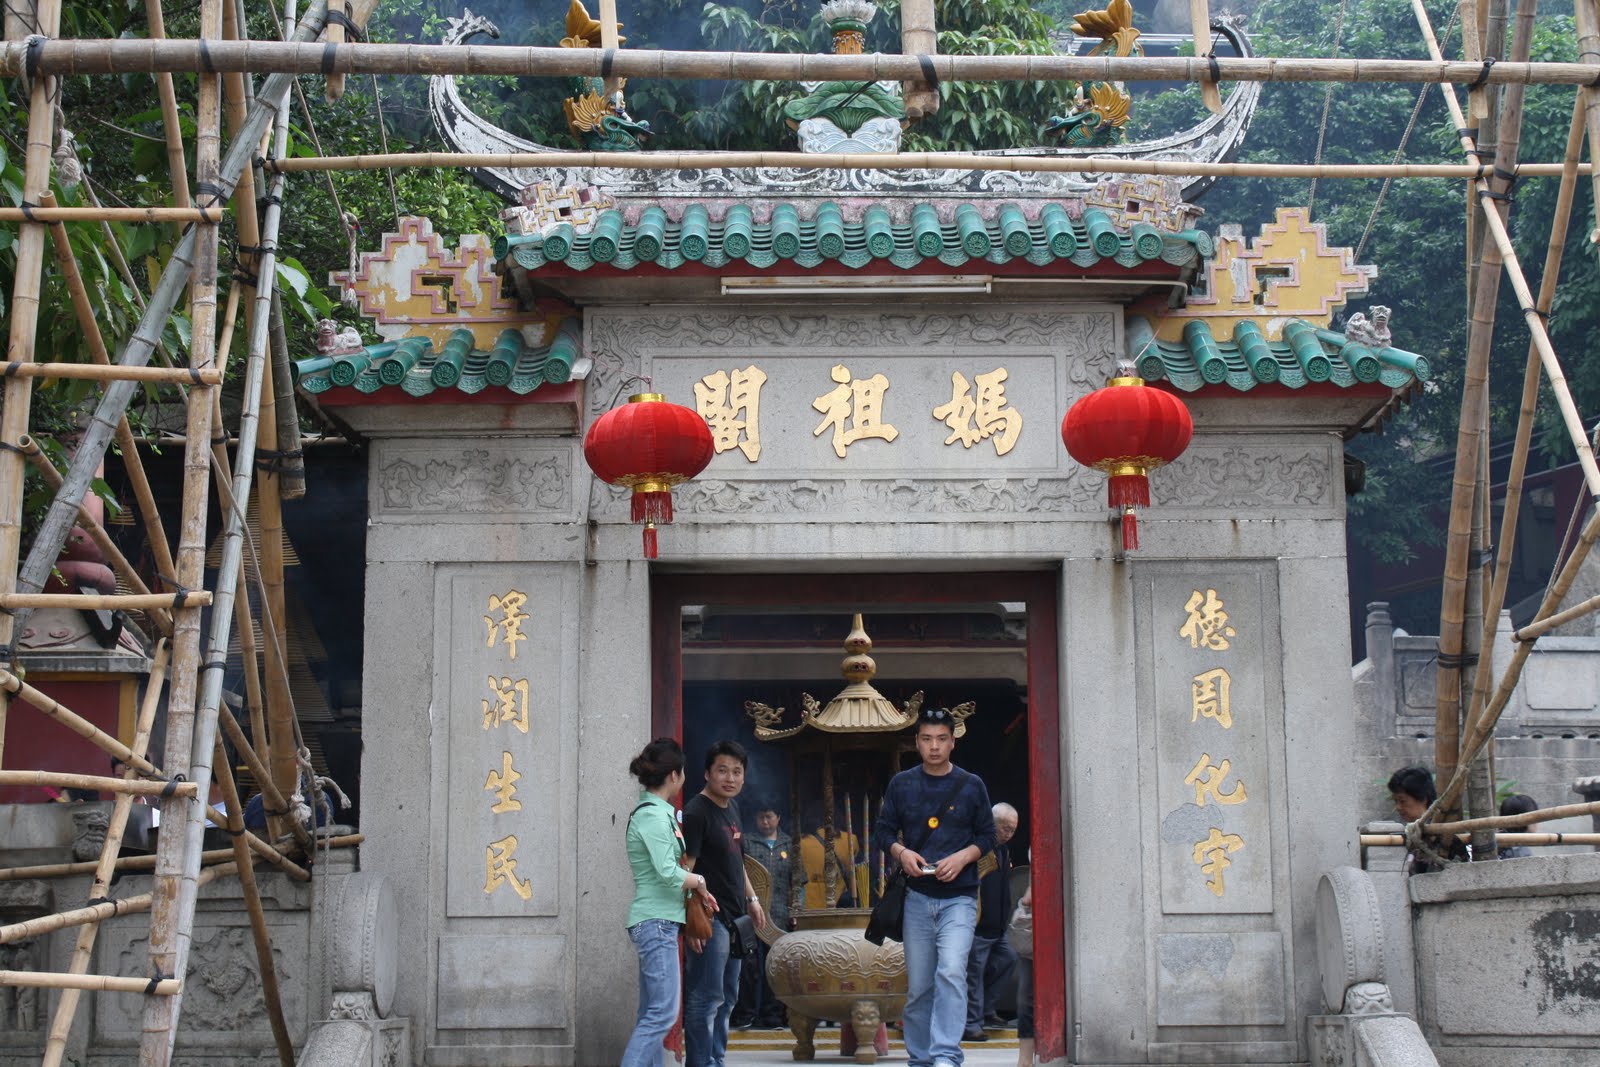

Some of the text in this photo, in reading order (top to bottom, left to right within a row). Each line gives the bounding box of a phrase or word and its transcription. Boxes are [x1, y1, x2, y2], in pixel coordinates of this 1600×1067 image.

[482, 589, 533, 900] 澤潤生民
[1179, 588, 1248, 897] 德周化宇
